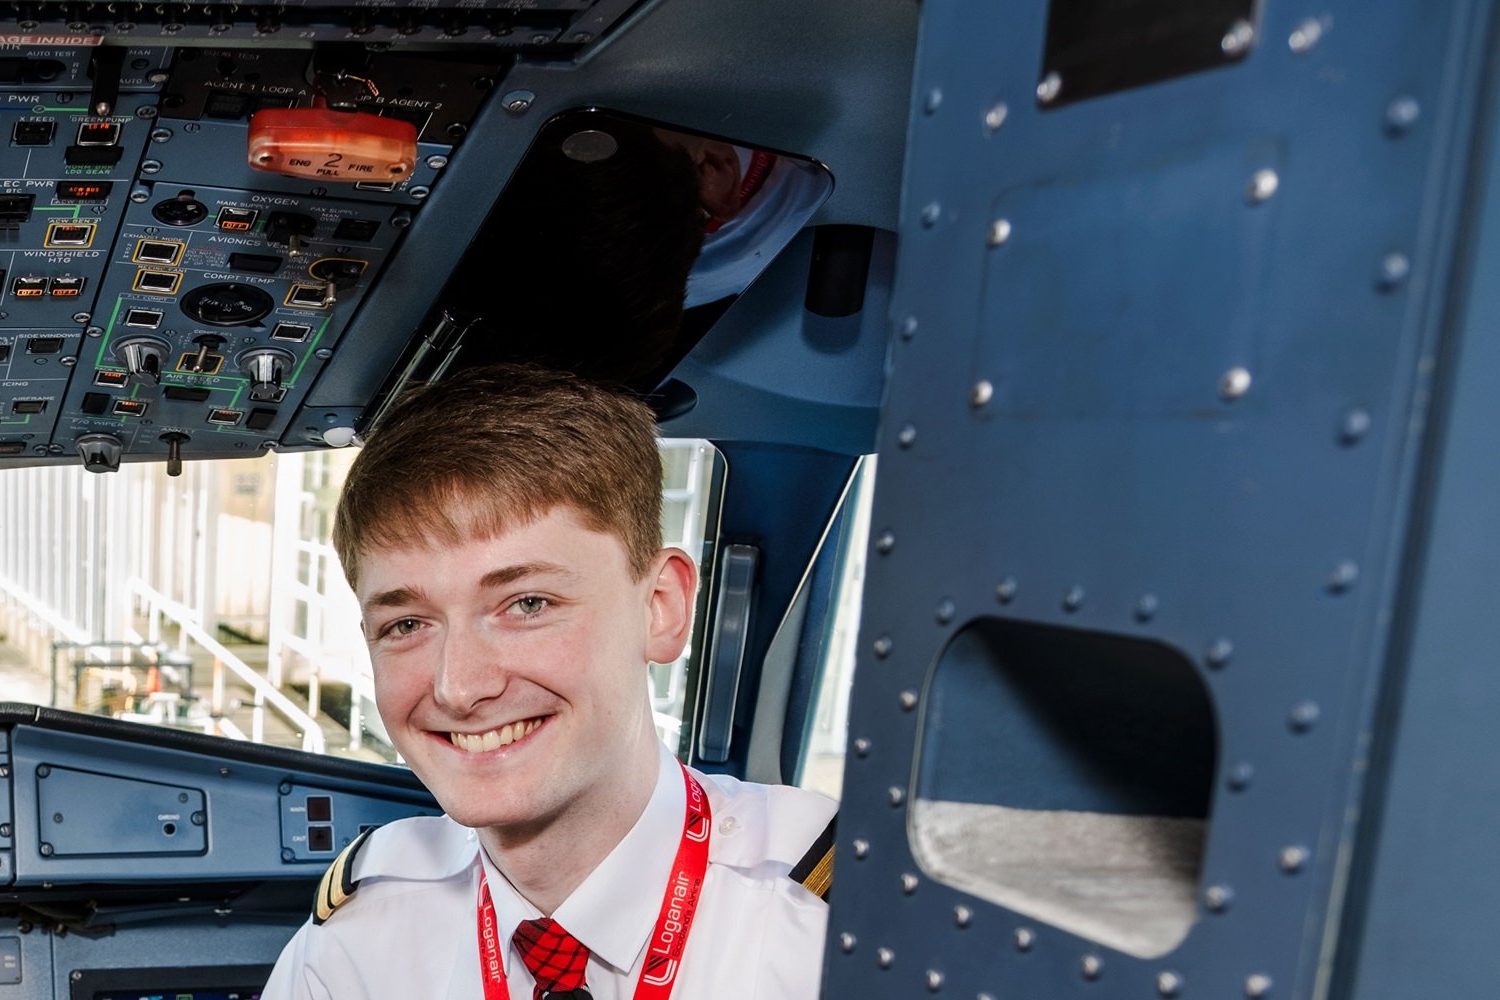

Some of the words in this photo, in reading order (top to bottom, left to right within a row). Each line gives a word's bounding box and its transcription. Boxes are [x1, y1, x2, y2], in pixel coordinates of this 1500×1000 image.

[8, 95, 40, 103] PWR
[289, 159, 311, 167] ENG
[324, 154, 342, 168] 2
[348, 164, 373, 173] FIRE
[252, 196, 299, 206] OXYGEN
[208, 237, 261, 246] AVIONICS
[203, 273, 240, 281] COMPT
[245, 276, 275, 284] TEMP
[653, 870, 690, 954] Loganair
[483, 905, 502, 984] Loganair
